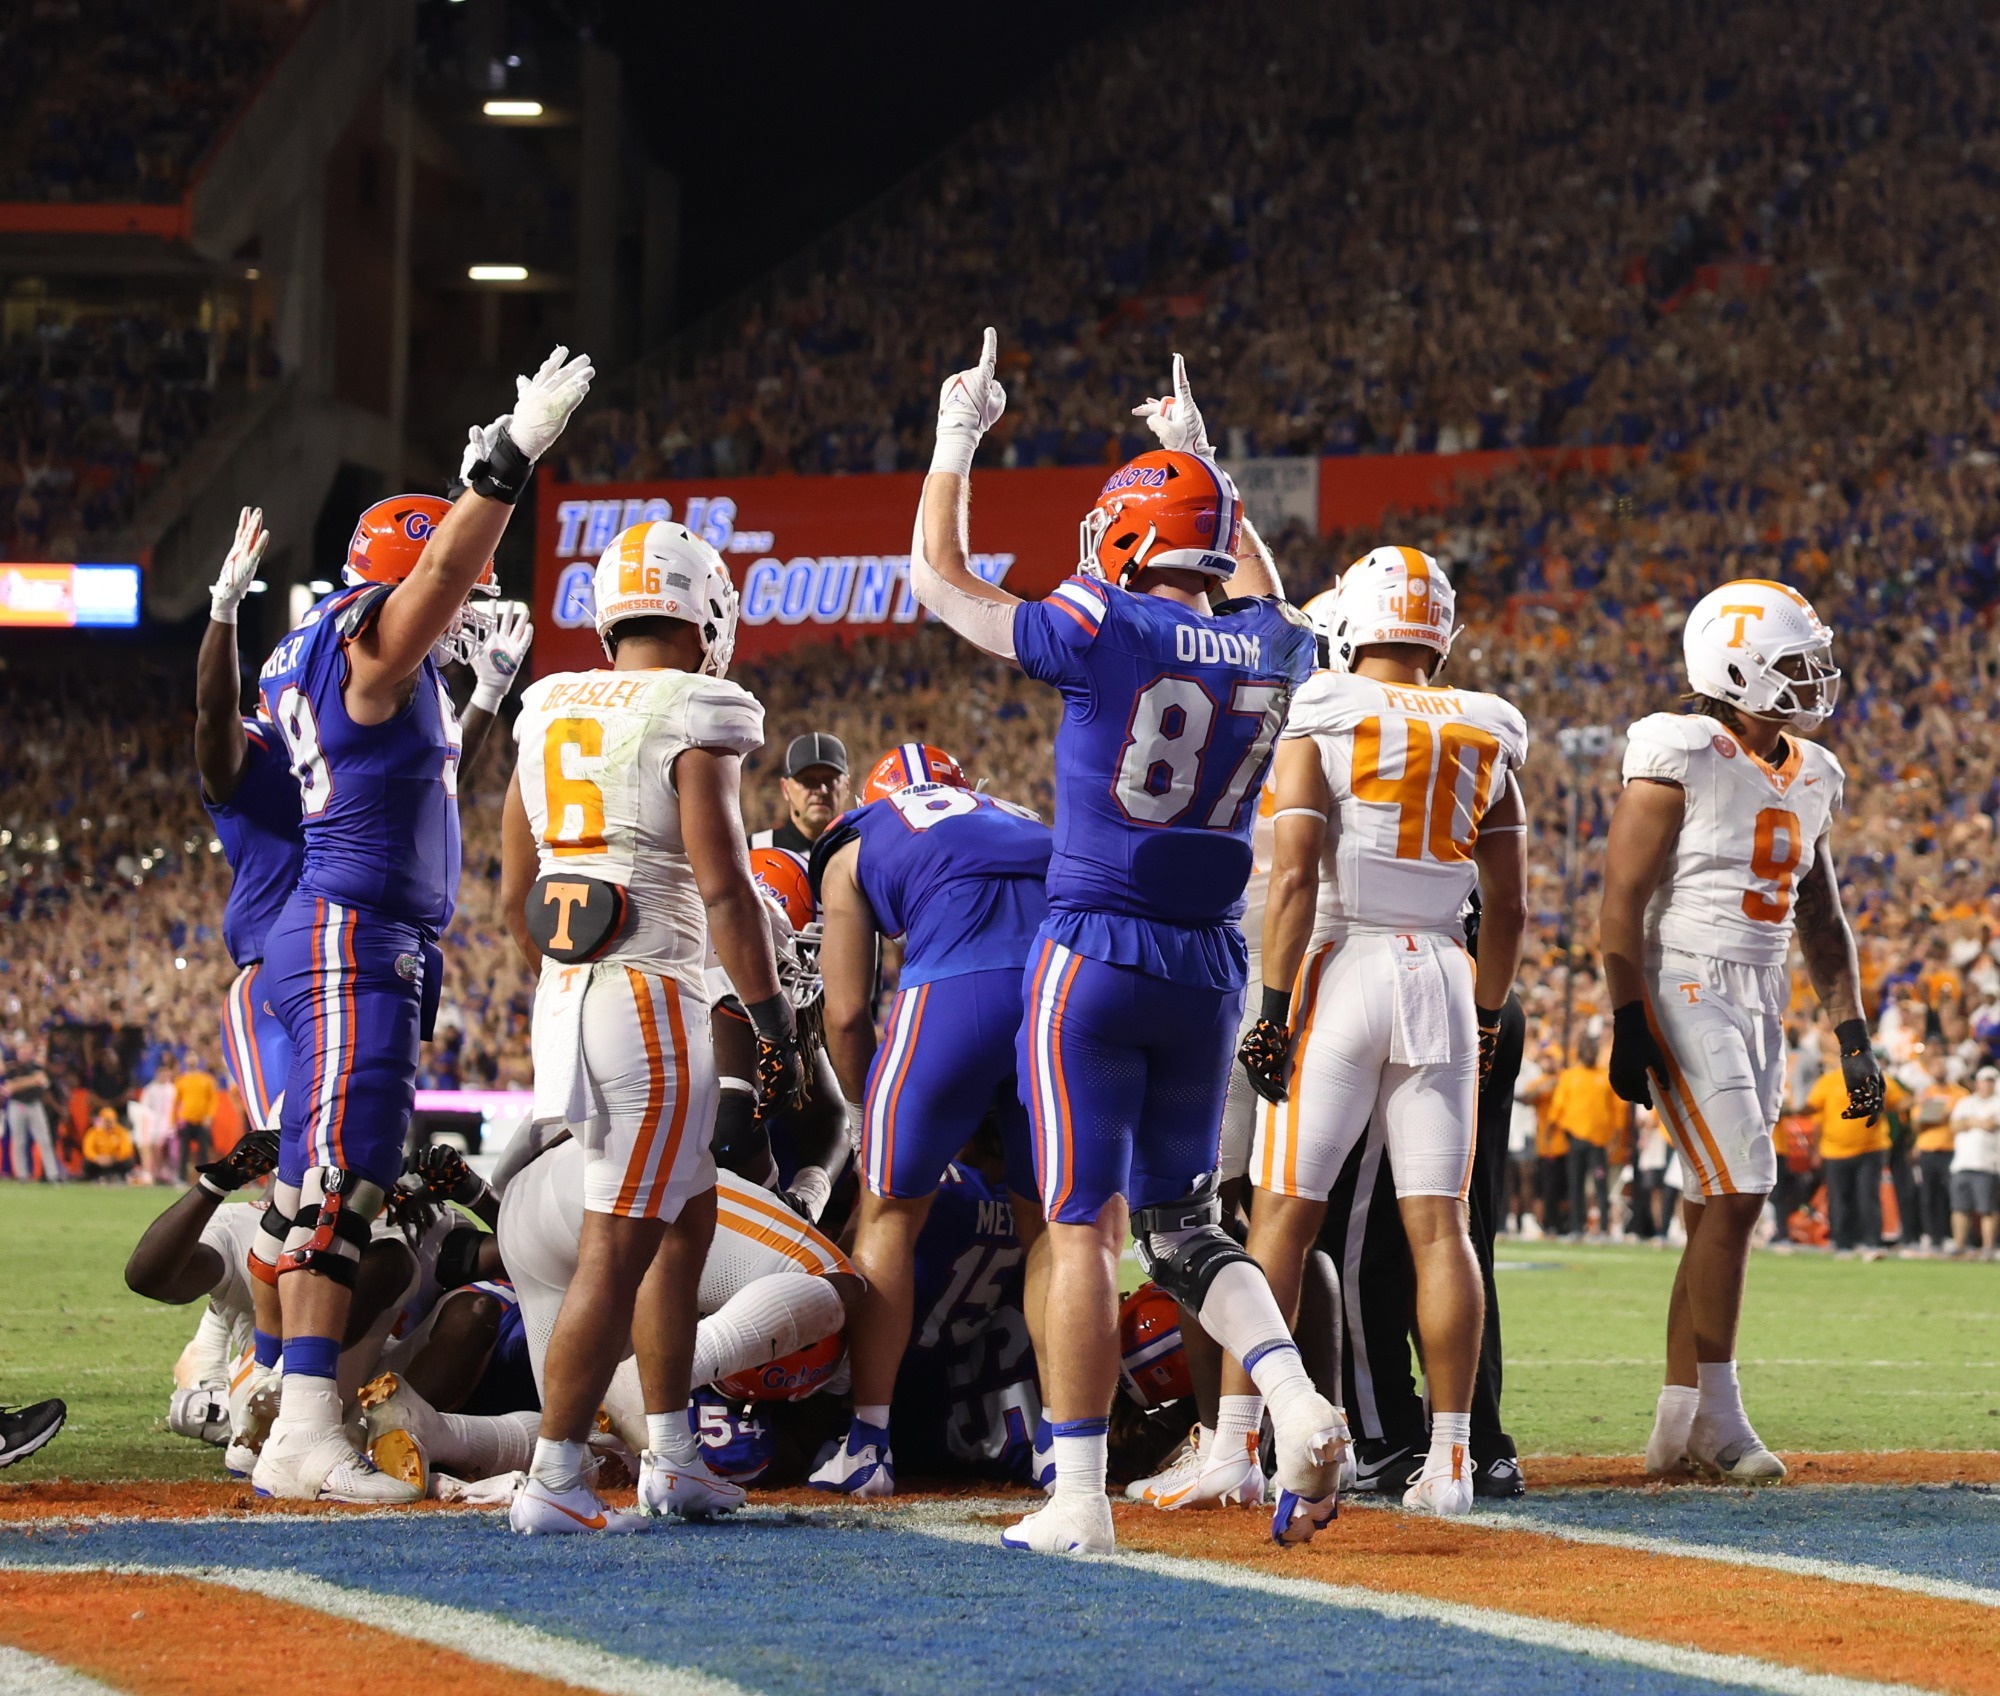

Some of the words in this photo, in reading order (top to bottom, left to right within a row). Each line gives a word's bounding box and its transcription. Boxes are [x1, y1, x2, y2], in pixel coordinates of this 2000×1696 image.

[1101, 464, 1166, 497] ators
[645, 567, 661, 594] 6
[742, 553, 1017, 625] COUNTY
[605, 599, 664, 617] TENNESSEE
[1720, 604, 1765, 649] T
[1175, 624, 1262, 671] ODOM
[540, 680, 648, 712] BEASLEY
[1381, 688, 1465, 716] PERRY
[1111, 672, 1290, 831] 87
[543, 717, 609, 858] 6
[1351, 715, 1501, 863] 40
[1772, 773, 1785, 790] T
[1741, 806, 1802, 924] 9
[544, 882, 590, 950] T
[1395, 934, 1419, 952] T
[560, 966, 581, 993] T
[1679, 982, 1703, 1004] T
[700, 1405, 766, 1449] 54
[665, 1474, 678, 1490] T
